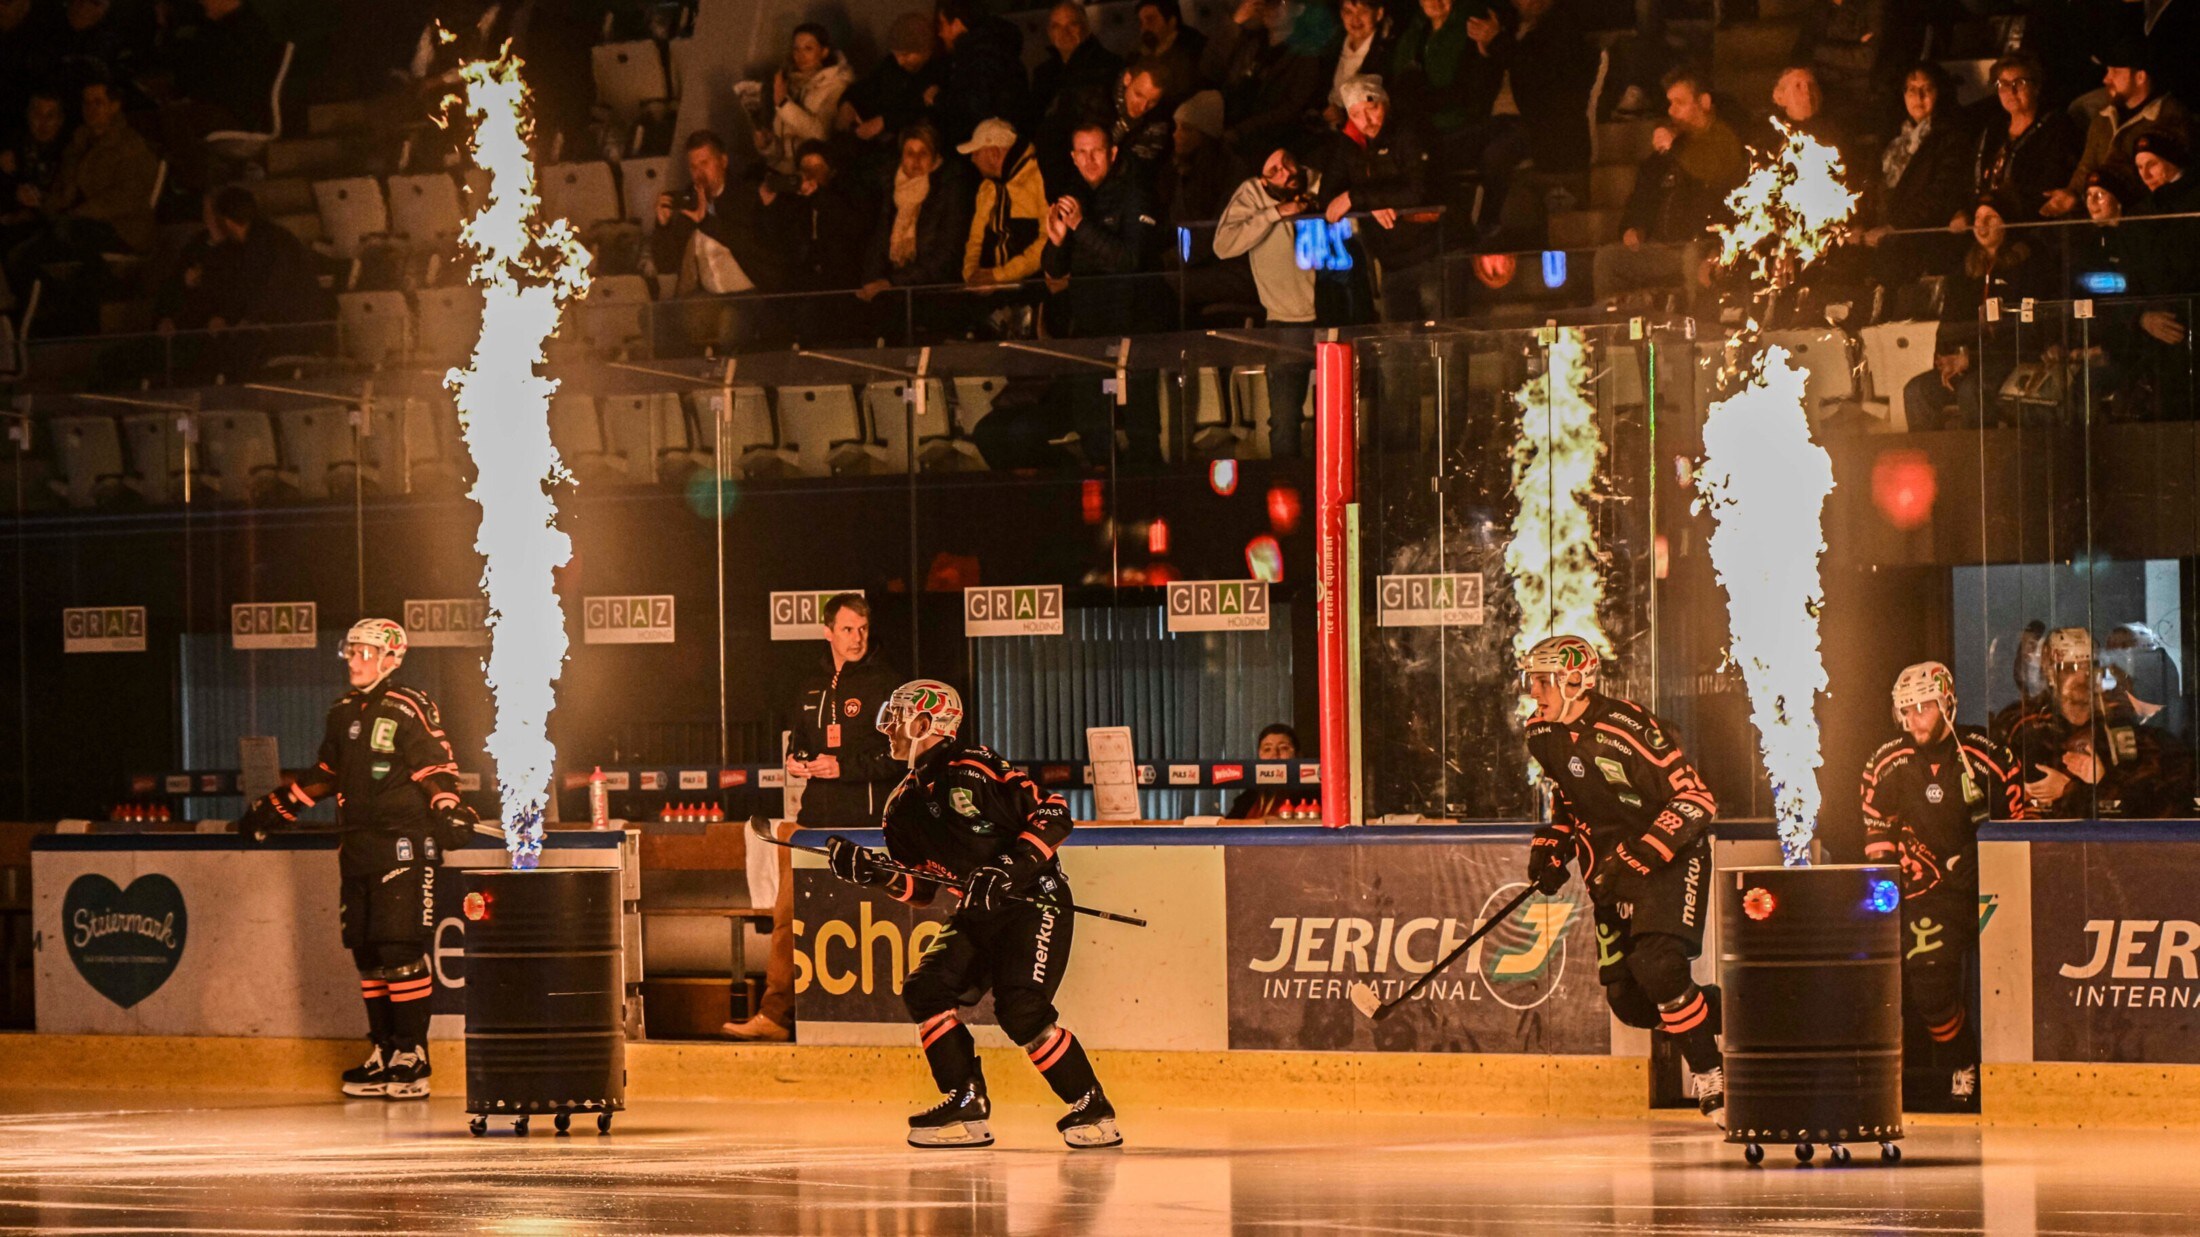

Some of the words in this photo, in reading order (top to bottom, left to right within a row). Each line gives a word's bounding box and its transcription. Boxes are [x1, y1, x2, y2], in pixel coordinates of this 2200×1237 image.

[970, 592, 1056, 618] GRAZ
[1173, 586, 1262, 613] GRAZ
[1383, 580, 1475, 607] GRAZ
[67, 613, 141, 636] GRAZ
[236, 609, 312, 632] GRAZ
[409, 605, 485, 630] GRAZ
[589, 602, 669, 626] GRAZ
[1228, 617, 1266, 627] HOLDING
[1023, 622, 1060, 632] HOLDING
[73, 908, 177, 949] Steiermark
[1249, 916, 1486, 974] JERICH
